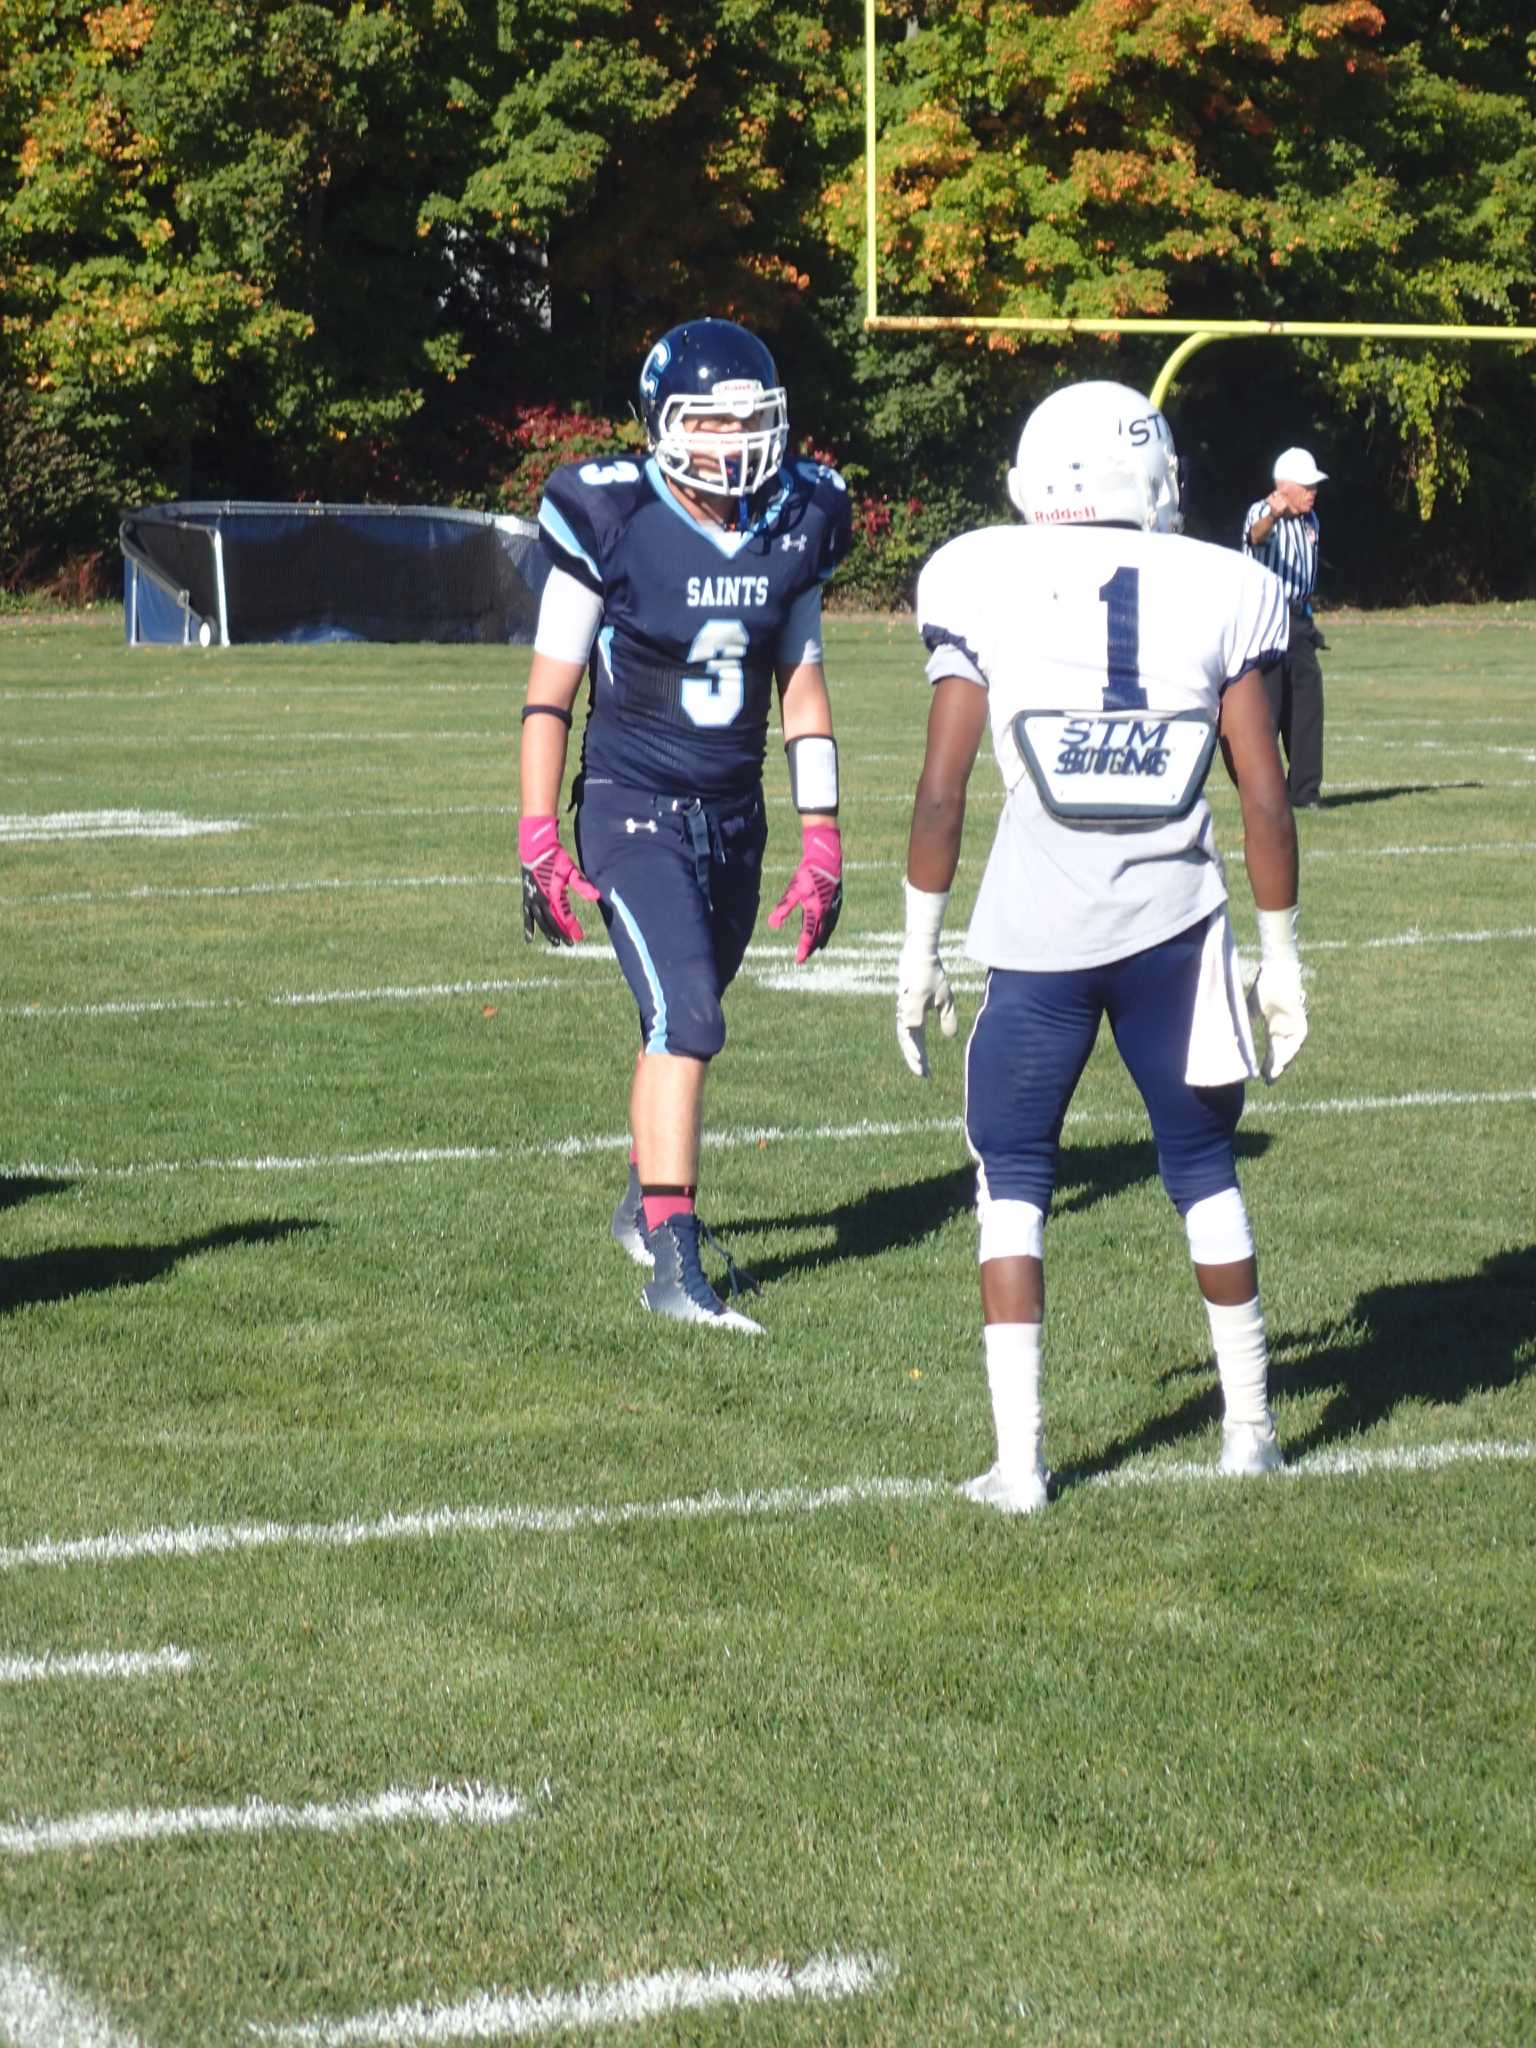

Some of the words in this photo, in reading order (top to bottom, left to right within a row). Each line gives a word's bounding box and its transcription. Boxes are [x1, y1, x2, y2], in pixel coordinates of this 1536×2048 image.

[1034, 505, 1097, 525] Riddell
[686, 576, 769, 607] SAINTS
[1099, 566, 1149, 712] 1
[681, 618, 750, 728] 3
[1059, 719, 1169, 748] STM
